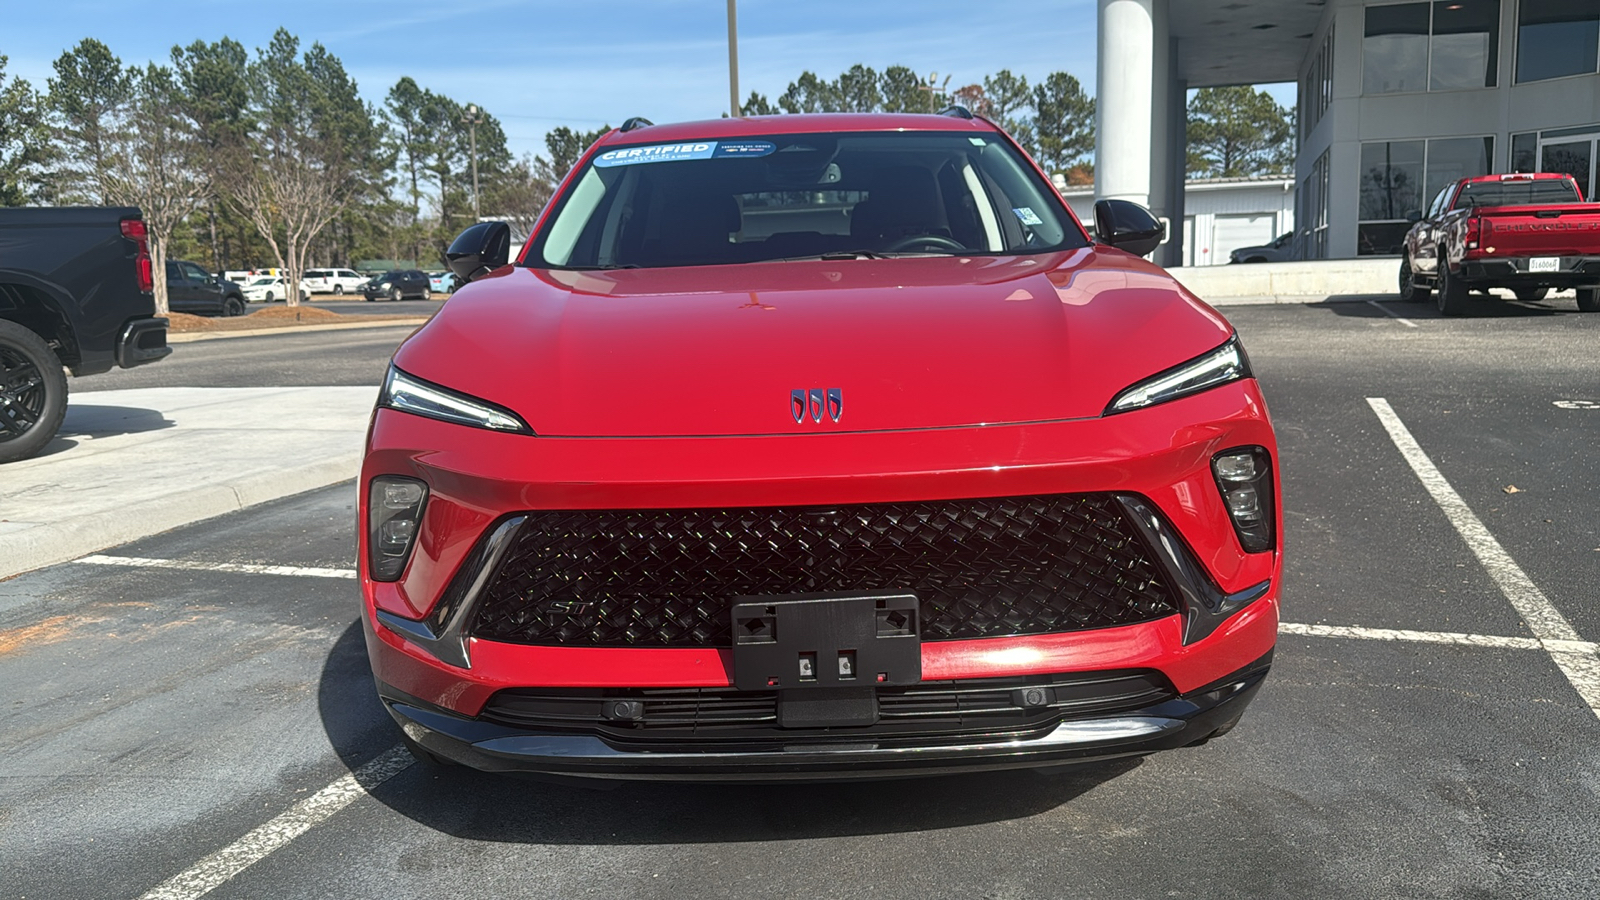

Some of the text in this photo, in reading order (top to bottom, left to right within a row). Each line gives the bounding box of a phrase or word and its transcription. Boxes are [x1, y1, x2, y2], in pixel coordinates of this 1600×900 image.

[602, 144, 709, 160] CERTIFIED
[1495, 222, 1600, 232] CHEVROLET
[547, 601, 593, 615] ST
